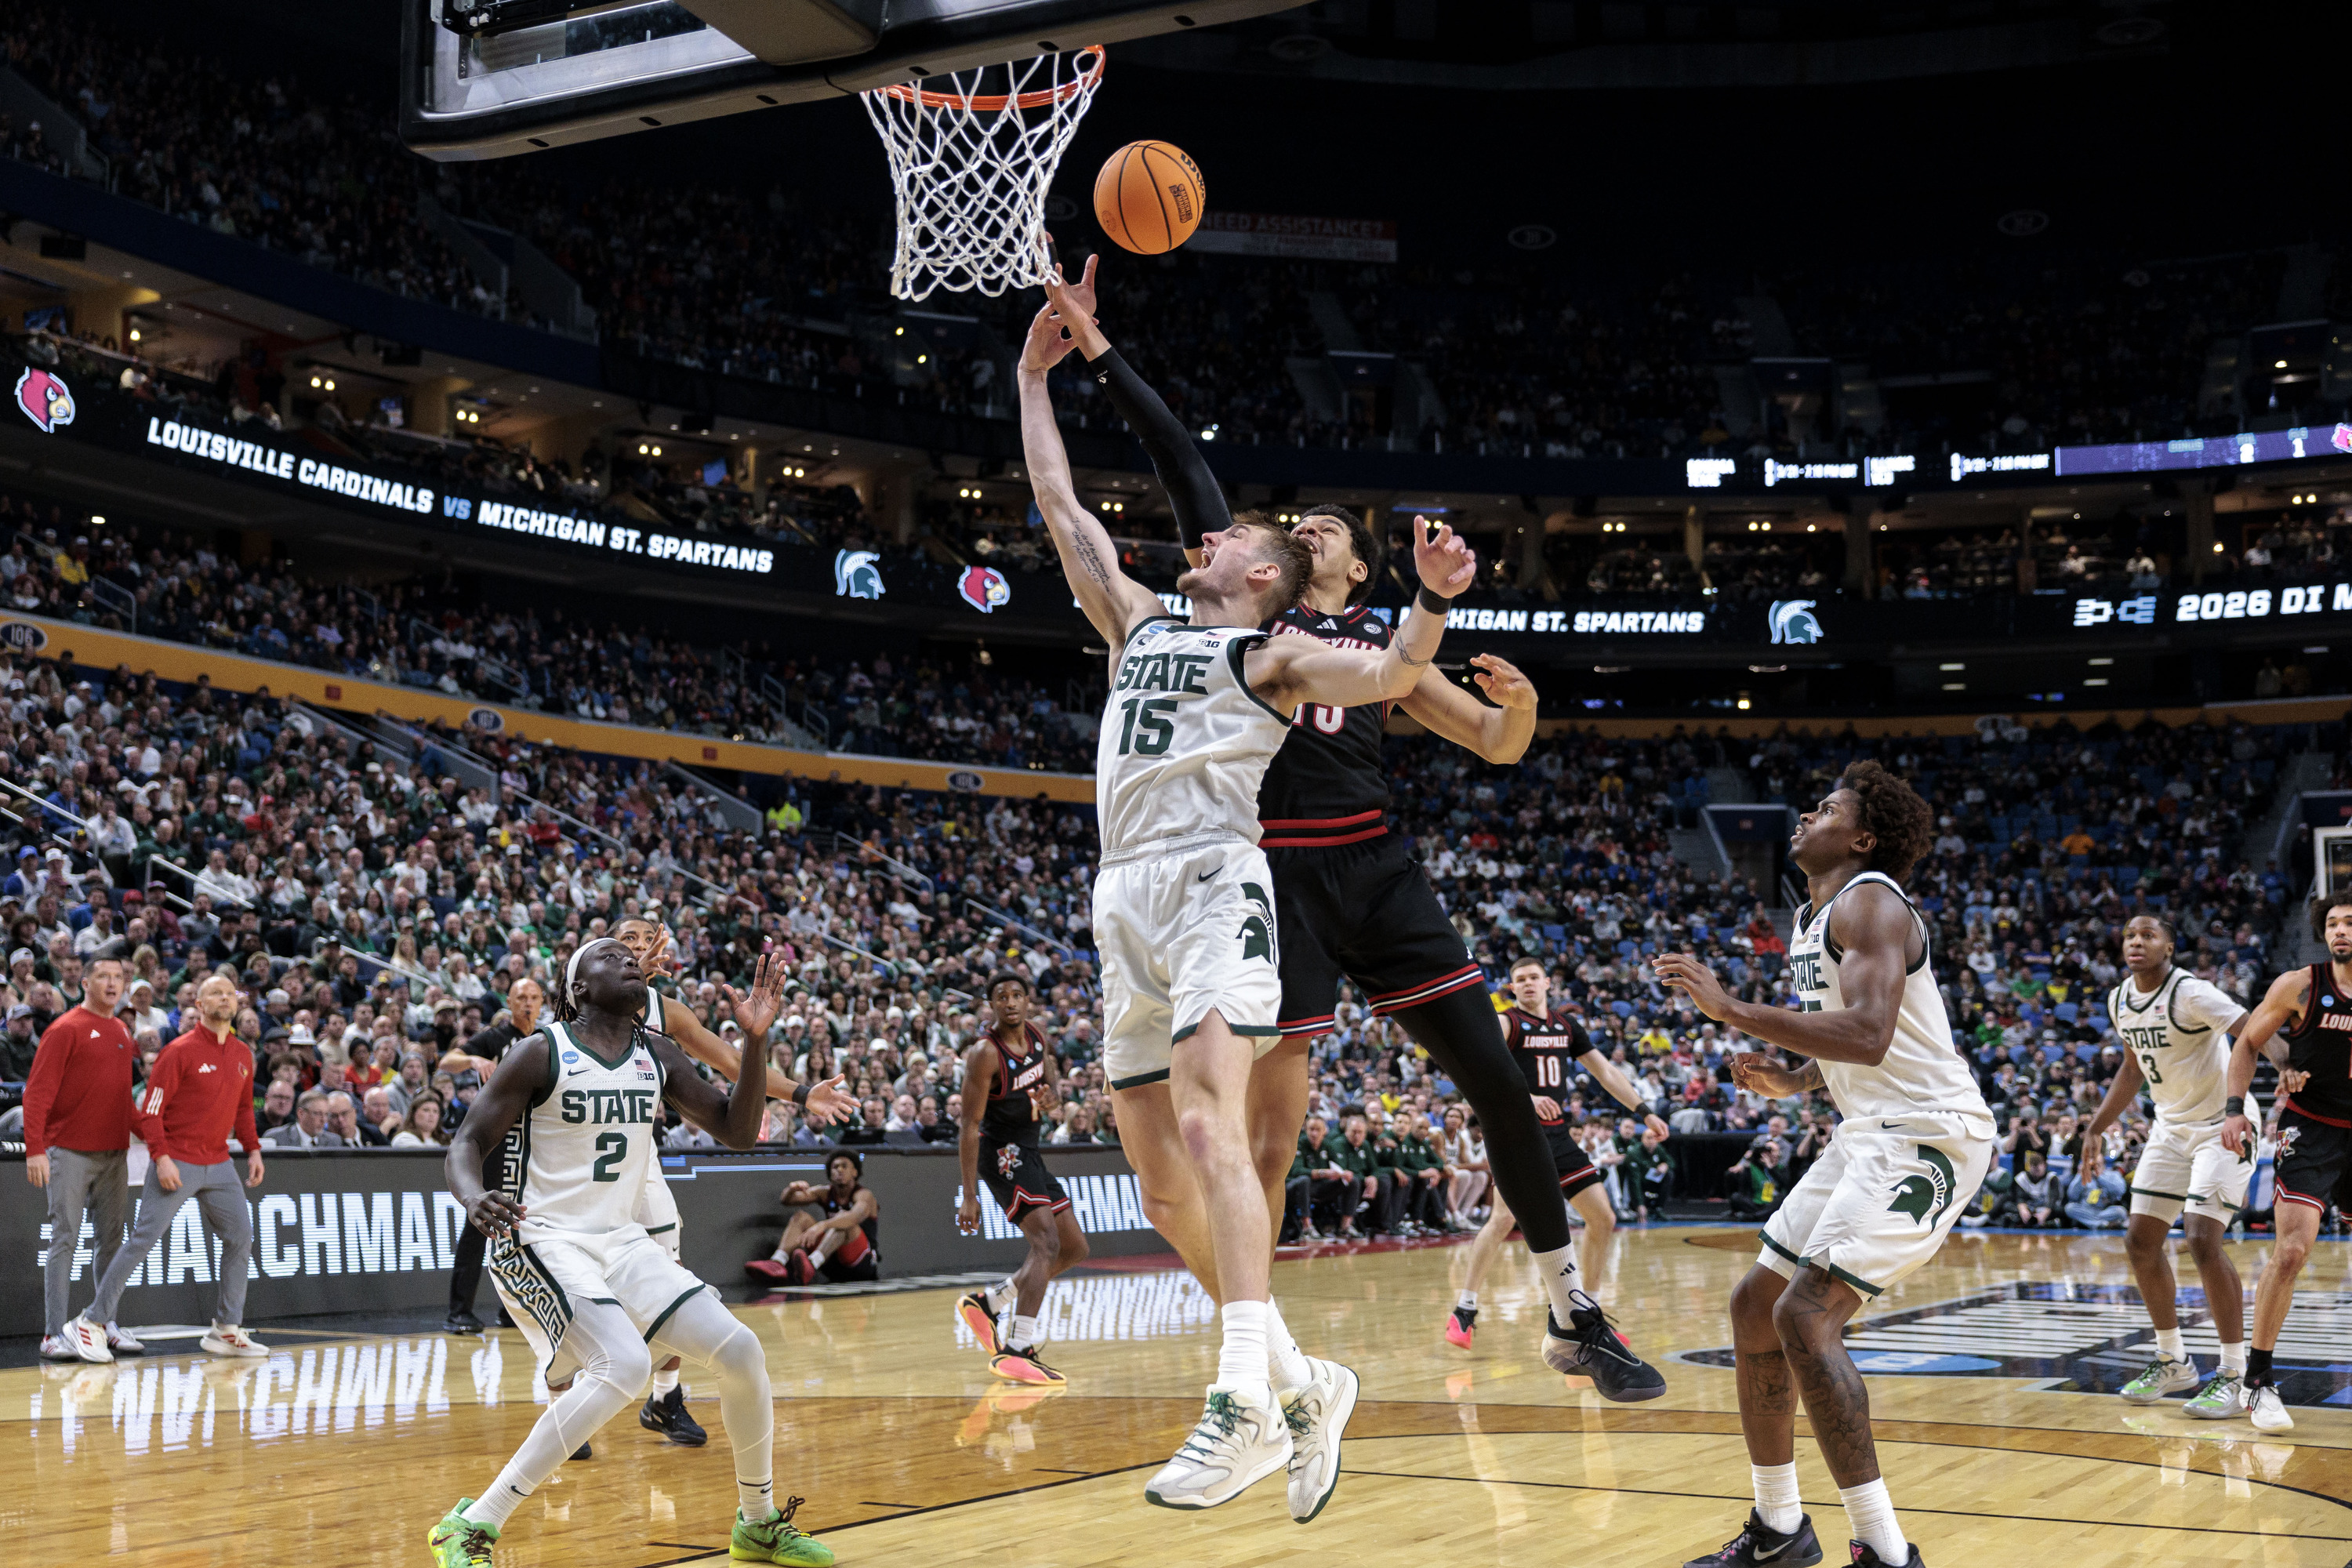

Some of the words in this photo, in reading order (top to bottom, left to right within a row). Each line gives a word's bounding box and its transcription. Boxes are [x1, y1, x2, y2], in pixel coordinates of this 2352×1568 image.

[1202, 212, 1251, 231] NEED
[1256, 216, 1384, 238] ASSISTANCE?
[2239, 443, 2254, 463] 2
[2292, 437, 2306, 458] 1
[147, 416, 296, 480] LOUISVILLE
[298, 457, 434, 514] CARDINALS
[443, 495, 471, 521] VS
[477, 500, 606, 547] MICHIGAN
[609, 525, 643, 554] ST.
[647, 534, 774, 573] SPARTANS
[2176, 590, 2272, 622] 2026
[2280, 585, 2325, 615] DI
[11, 625, 34, 646] 106
[1531, 610, 1569, 633] ST.
[1573, 611, 1705, 633] SPARTANS
[1116, 652, 1214, 695] STATE
[1119, 698, 1178, 756] 15
[1523, 1035, 1569, 1049] LOUISVILLE
[2122, 1025, 2172, 1049] STATE
[1534, 1054, 1561, 1088] 10
[2142, 1054, 2163, 1083] 3
[561, 1089, 655, 1124] STATE
[593, 1132, 628, 1182] 2
